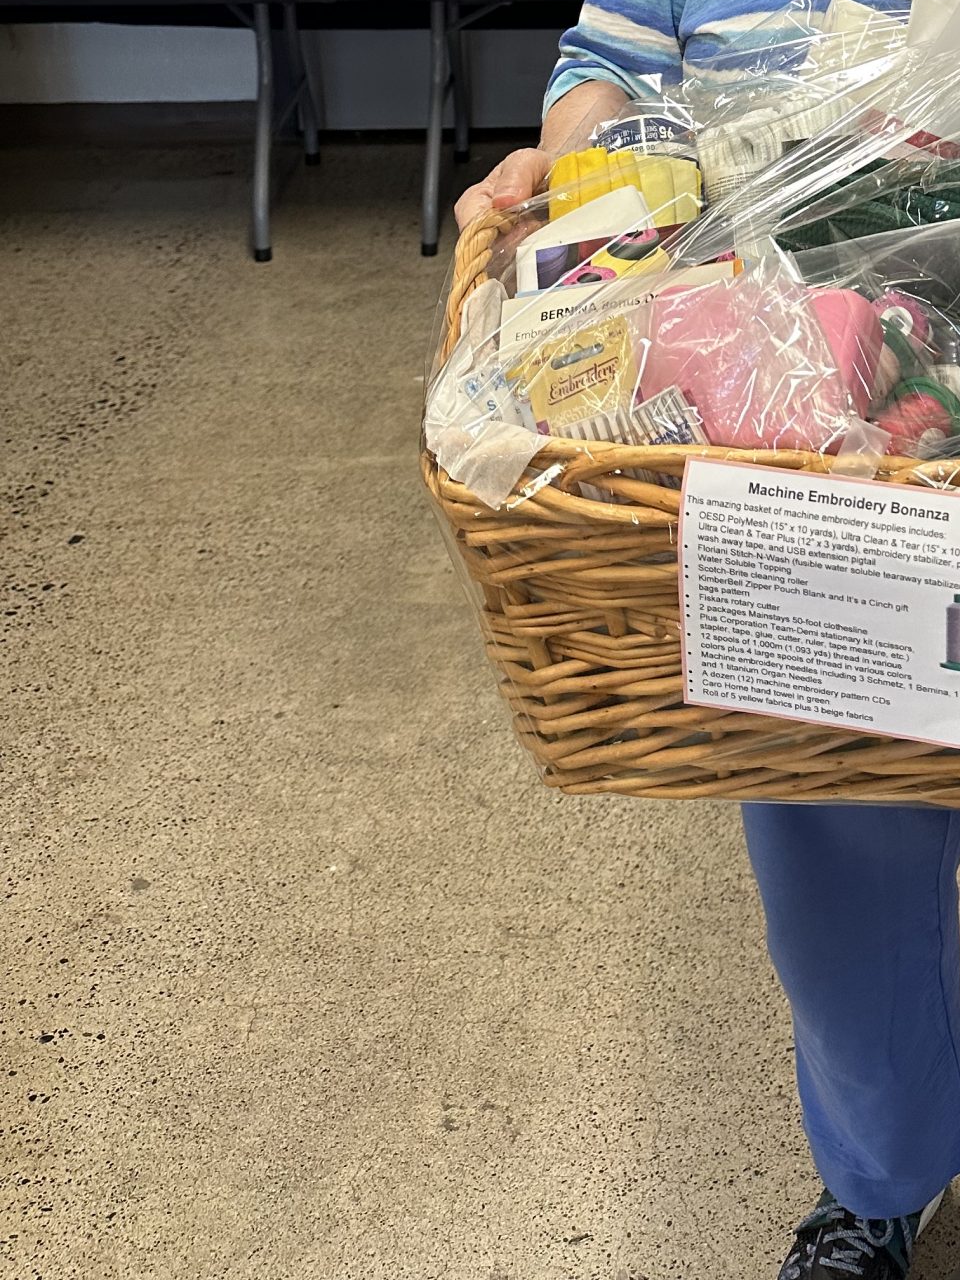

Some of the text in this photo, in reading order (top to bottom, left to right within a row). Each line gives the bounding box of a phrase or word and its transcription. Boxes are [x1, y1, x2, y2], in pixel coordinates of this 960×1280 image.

[550, 361, 619, 400] Embroidery
[686, 494, 704, 503] This
[705, 499, 741, 509] amazing
[743, 503, 772, 513] basket
[773, 507, 783, 515] of
[783, 509, 819, 520] machine
[821, 515, 869, 527] embroidery
[870, 522, 906, 533] supplies
[748, 482, 949, 521] Machine Embroidery Bonanza
[697, 534, 719, 542] wash
[720, 537, 743, 546] away
[768, 544, 784, 552] and
[786, 545, 806, 555] USB
[807, 550, 849, 561] extension
[850, 556, 876, 565] pigtail
[698, 511, 725, 521] OESD
[727, 515, 768, 527] PolyMesh
[797, 525, 807, 533] 10
[840, 531, 861, 541] Ultra
[863, 535, 888, 545] Clean
[890, 539, 898, 547] &
[899, 540, 920, 550] Tear
[950, 548, 960, 556] 10
[698, 522, 718, 531] Ultra
[719, 525, 744, 535] Clean
[746, 528, 753, 537] &
[755, 530, 775, 539] Tear
[776, 533, 795, 543] Plus
[823, 540, 830, 548] 3
[862, 547, 911, 560] embroidery
[697, 543, 728, 554] Floriani
[729, 548, 790, 563] Stitch-N-Wash
[791, 557, 823, 568] (fusible
[824, 564, 848, 572] water
[850, 567, 881, 577] soluble
[882, 571, 922, 583] tearaway
[697, 553, 791, 574] Water Soluble Topping
[697, 563, 808, 585] Scotch-Brite cleaning roller
[697, 574, 744, 586] KimberBell
[744, 580, 772, 590] Zipper
[773, 584, 800, 594] Pouch
[802, 589, 826, 598] Blank
[846, 595, 859, 603] It's
[868, 599, 893, 609] Cinch
[698, 583, 750, 596] bags pattern
[698, 593, 780, 611] Fiskars rotary cutter
[699, 612, 718, 621] Plus
[719, 615, 768, 628] Corporation
[769, 623, 819, 636] Team-Demi
[820, 631, 861, 644] stationary
[862, 637, 873, 645] kit
[706, 605, 747, 616] packages
[748, 610, 790, 622] Mainstays
[791, 616, 822, 627] 50-foot
[823, 622, 868, 634] clothesline
[709, 671, 735, 680] dozen
[755, 678, 791, 688] machine
[792, 684, 839, 697] embroidery
[840, 692, 870, 701] pattern
[871, 695, 890, 705] CDs
[726, 663, 759, 673] titanium
[760, 668, 787, 678] Organ
[788, 672, 822, 684] Needles
[701, 678, 722, 687] Caro
[724, 682, 749, 691] Home
[750, 686, 771, 695] hand
[772, 689, 795, 698] towel
[806, 696, 830, 704] green
[702, 688, 719, 696] Roll
[737, 694, 763, 703] yellow
[765, 698, 792, 708] fabrics
[794, 703, 812, 711] plus
[820, 706, 844, 716] beige
[845, 710, 873, 721] fabrics
